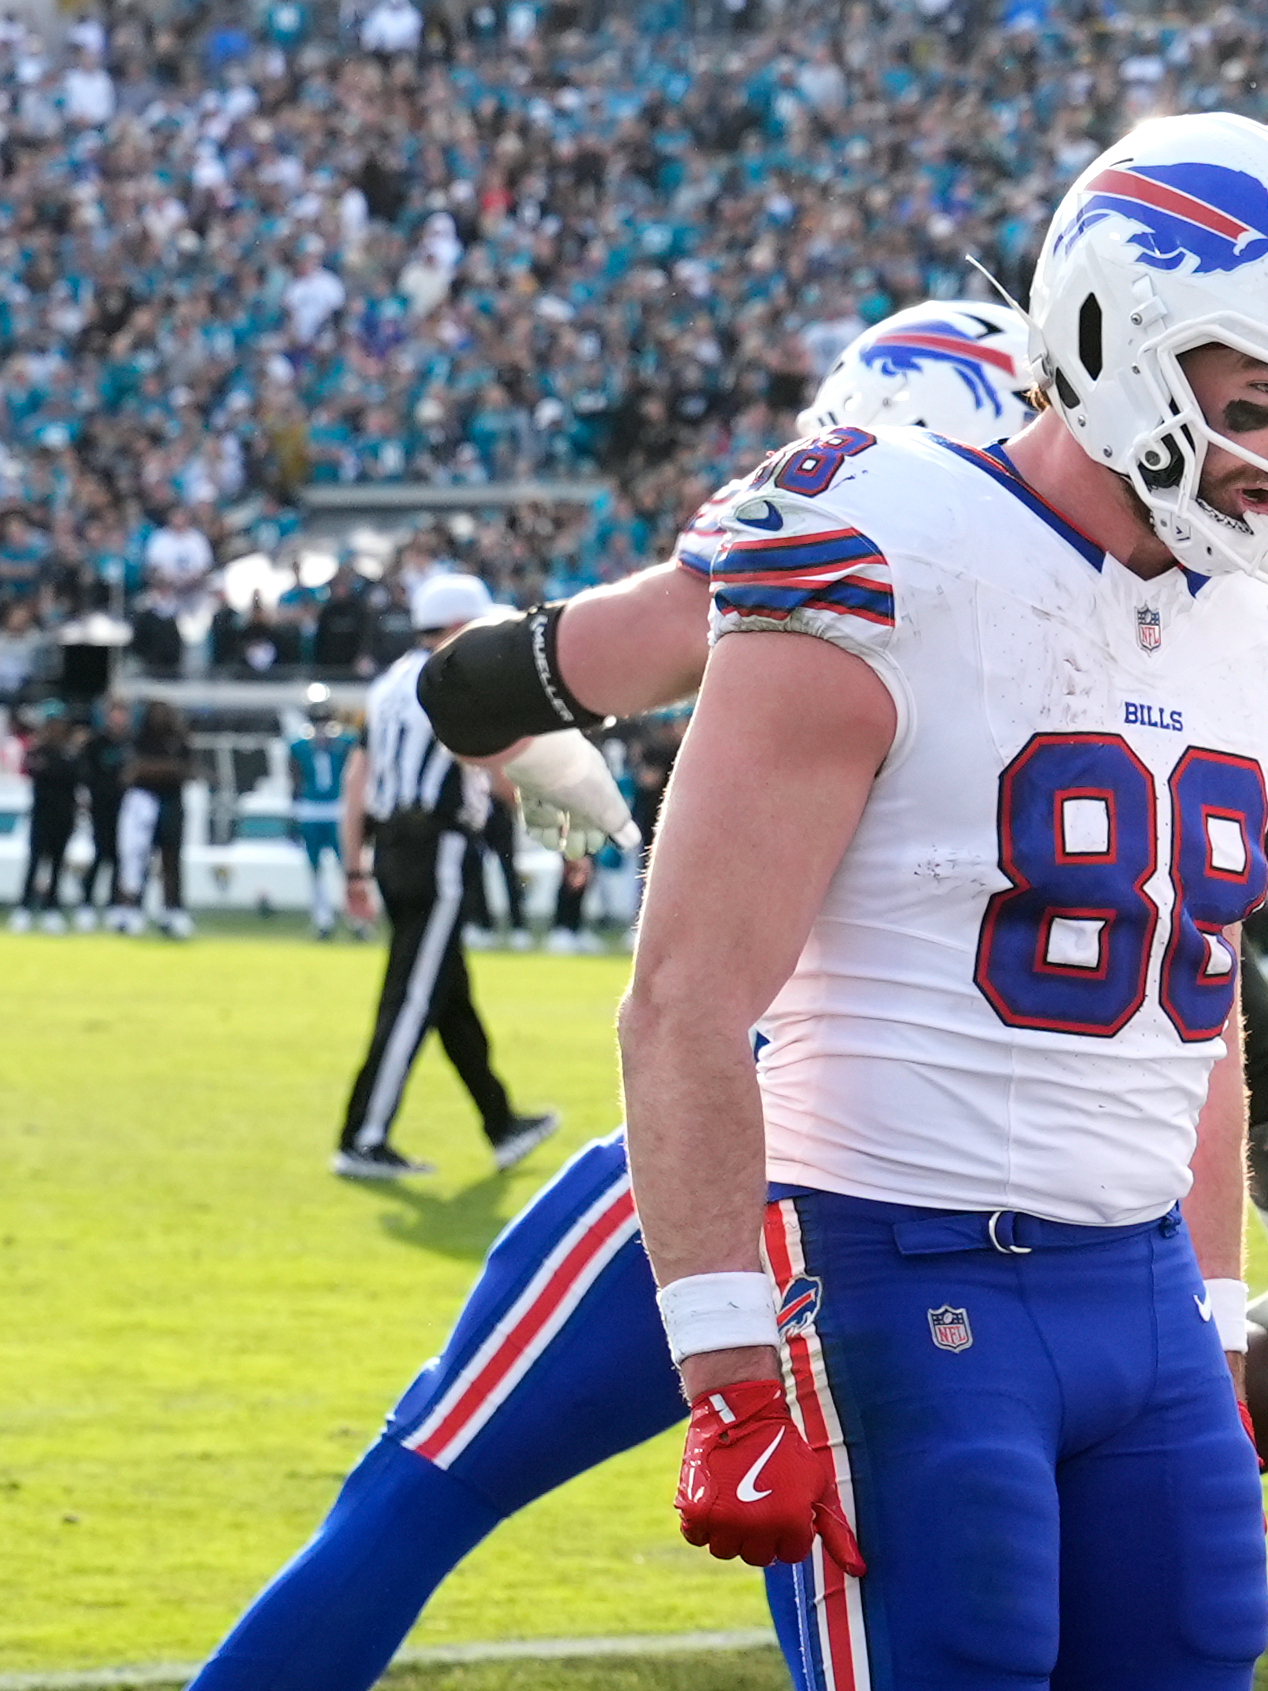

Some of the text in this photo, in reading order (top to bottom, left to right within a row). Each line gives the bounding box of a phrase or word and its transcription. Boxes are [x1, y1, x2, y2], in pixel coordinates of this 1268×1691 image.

[1141, 626, 1160, 647] NFL
[1124, 701, 1184, 732] BILLS
[937, 1326, 966, 1344] NFL
